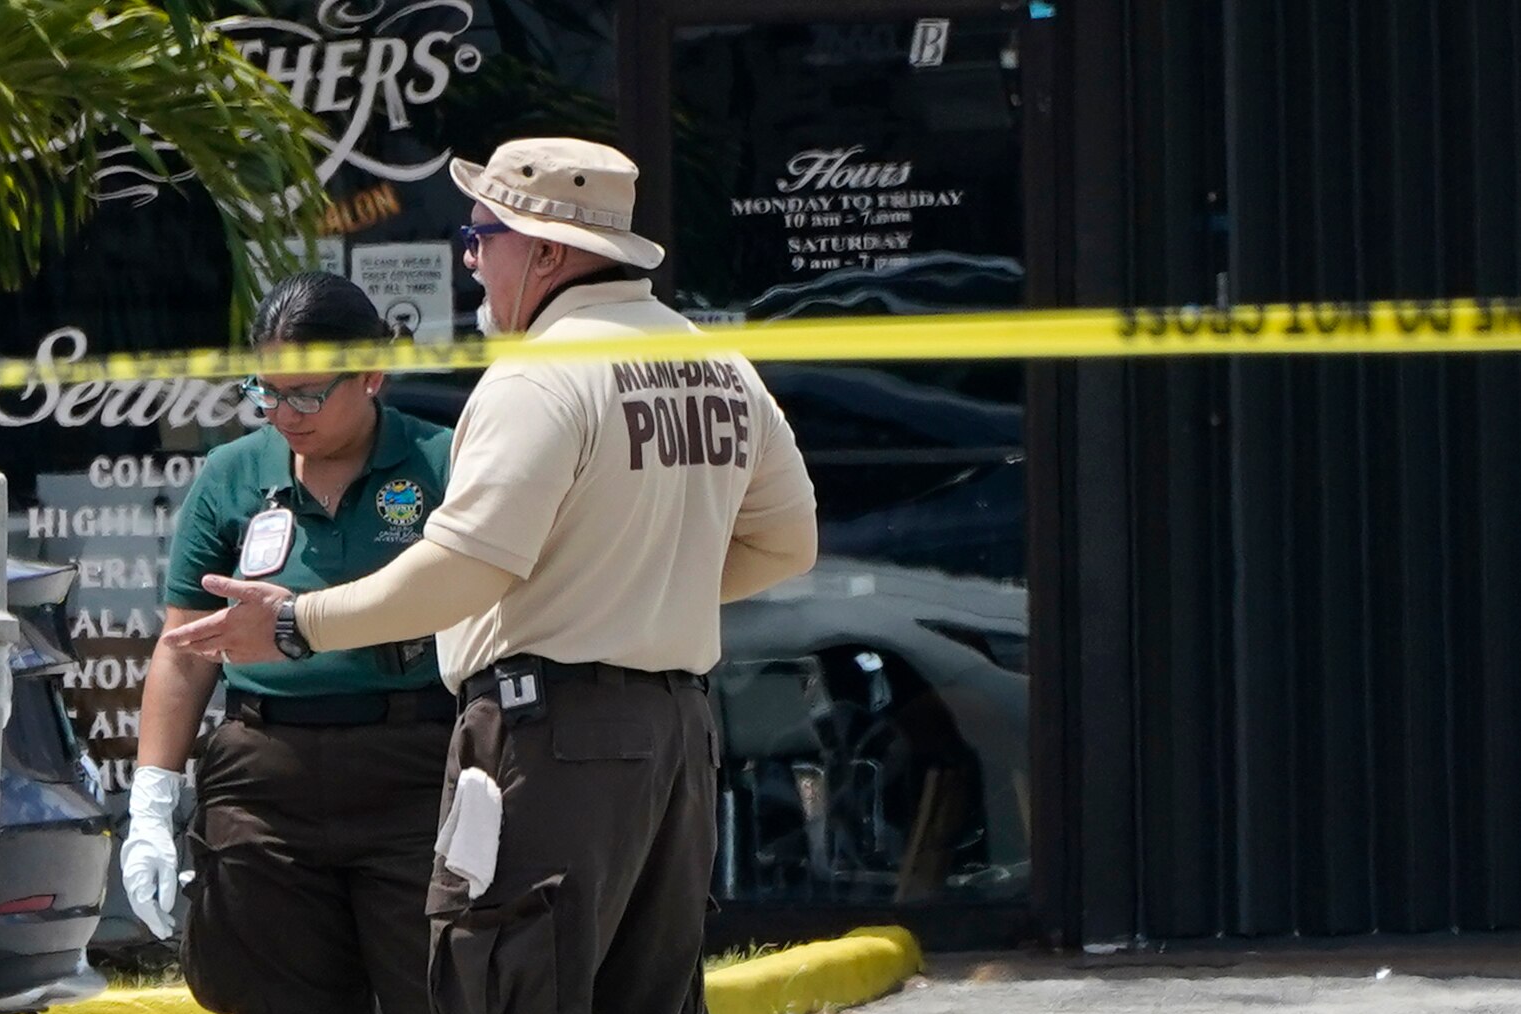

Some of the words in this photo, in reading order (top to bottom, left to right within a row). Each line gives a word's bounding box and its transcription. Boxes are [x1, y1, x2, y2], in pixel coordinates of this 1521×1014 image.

[777, 145, 913, 192] Hours
[731, 194, 833, 216] MONDAY
[840, 195, 873, 211] TO
[878, 190, 964, 208] FRIDAY
[784, 213, 806, 228] 10
[787, 232, 912, 253] SATURDAY
